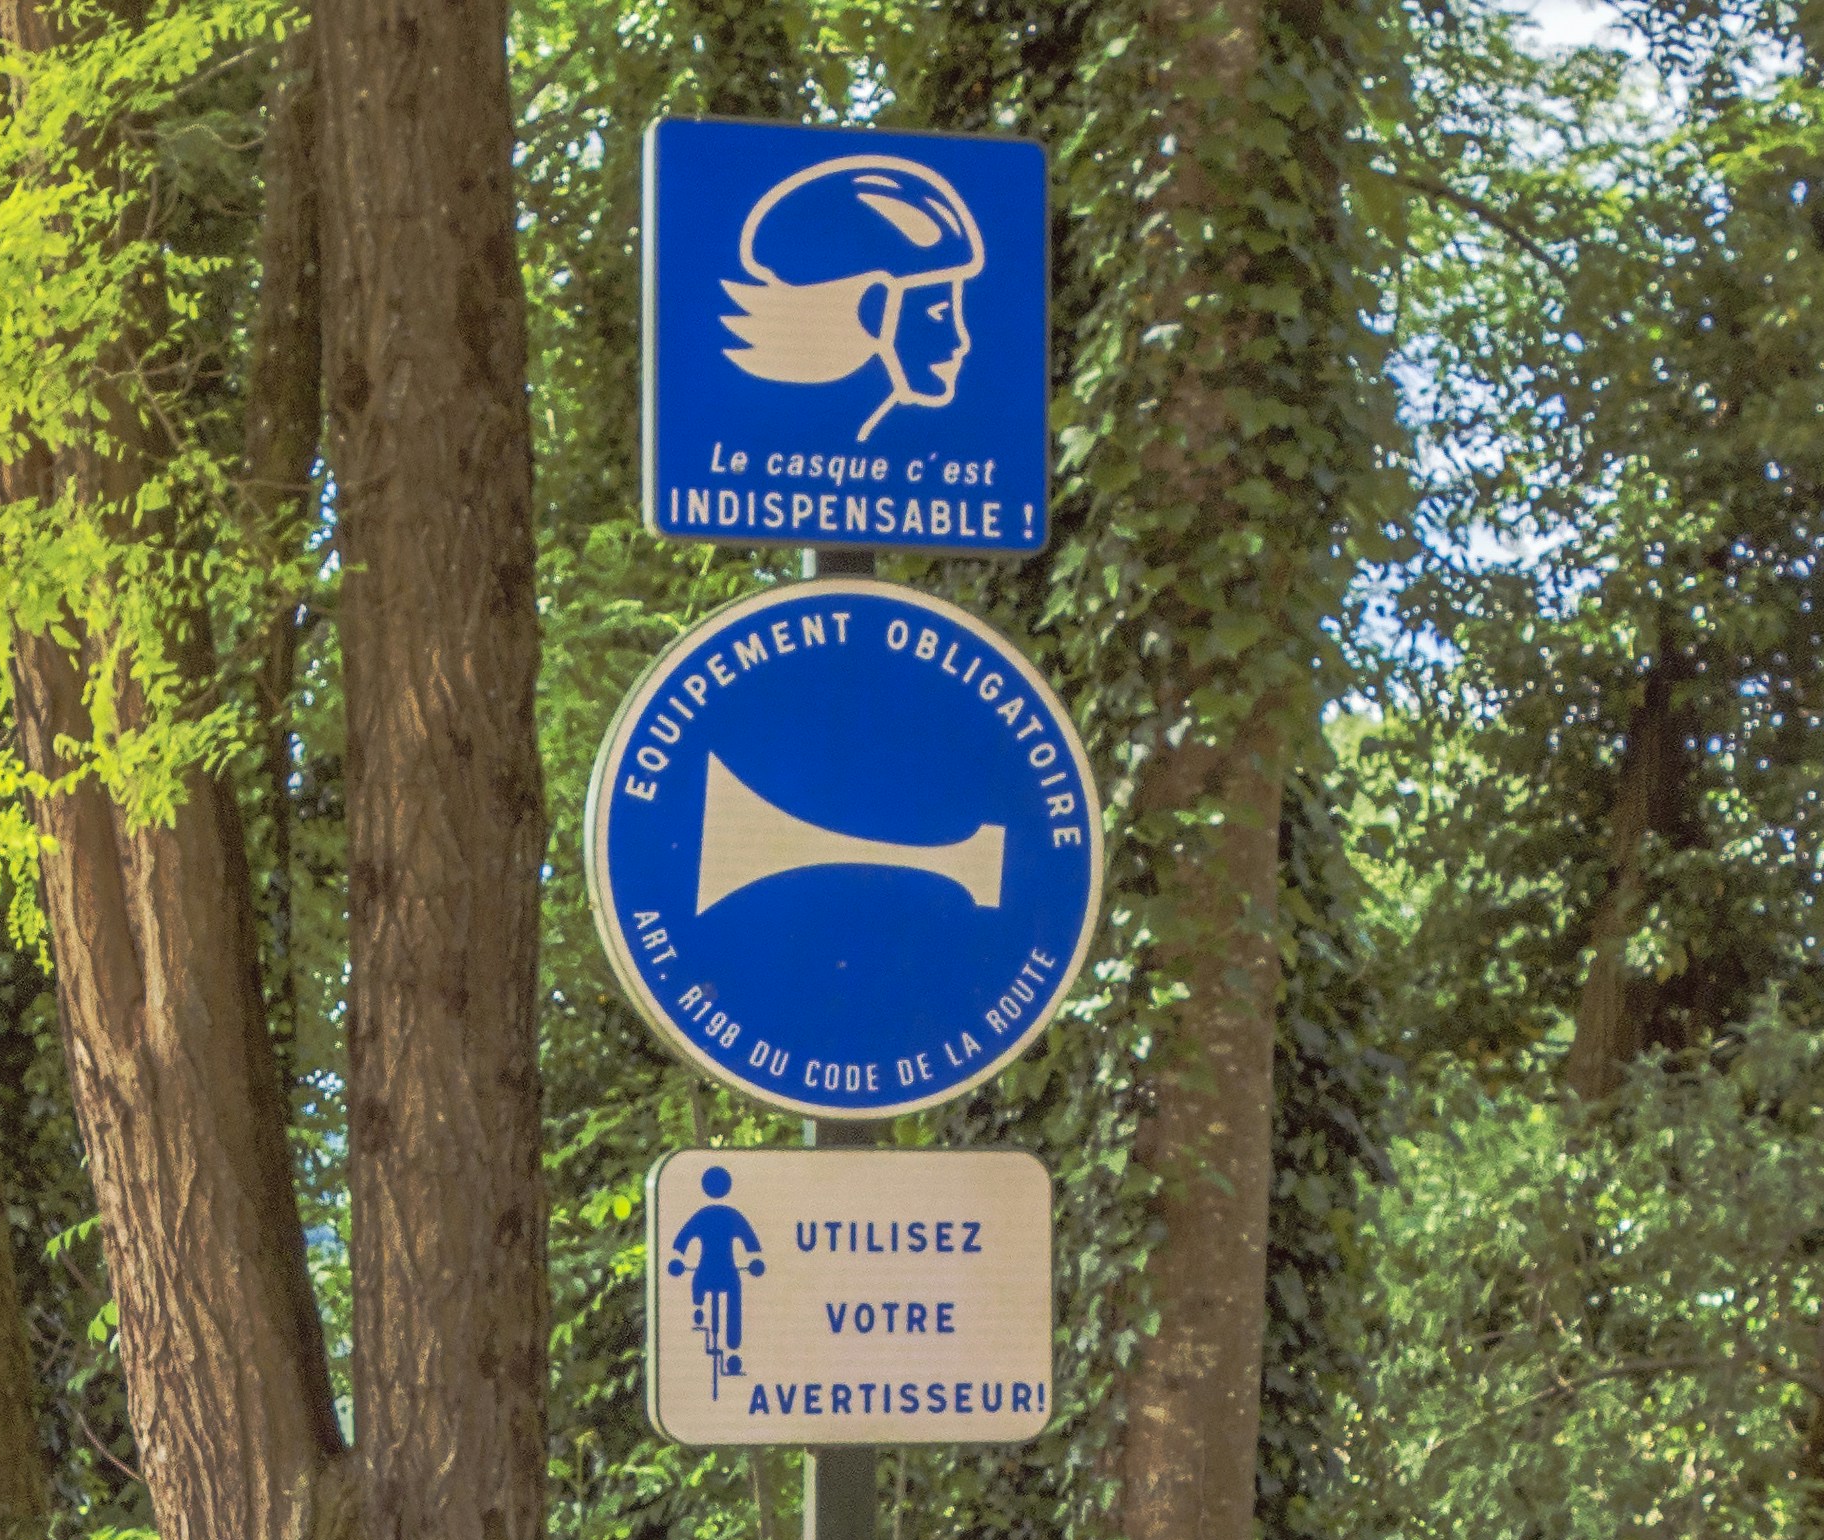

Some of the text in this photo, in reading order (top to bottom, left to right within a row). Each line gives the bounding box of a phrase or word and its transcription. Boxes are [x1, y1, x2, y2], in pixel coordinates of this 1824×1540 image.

[711, 442, 748, 473] Le
[767, 452, 889, 487] casque
[670, 488, 1002, 538] INDISPENSABLE
[625, 611, 1082, 848] EQUIPEMENT OBLIGATOIRE
[632, 911, 1057, 1093] ART. R198 DU CODE DE LA ROUTE
[796, 1221, 982, 1253] UTILISEZ
[825, 1301, 956, 1335] VOTRE
[748, 1381, 1046, 1416] AVERTISSEUR!
